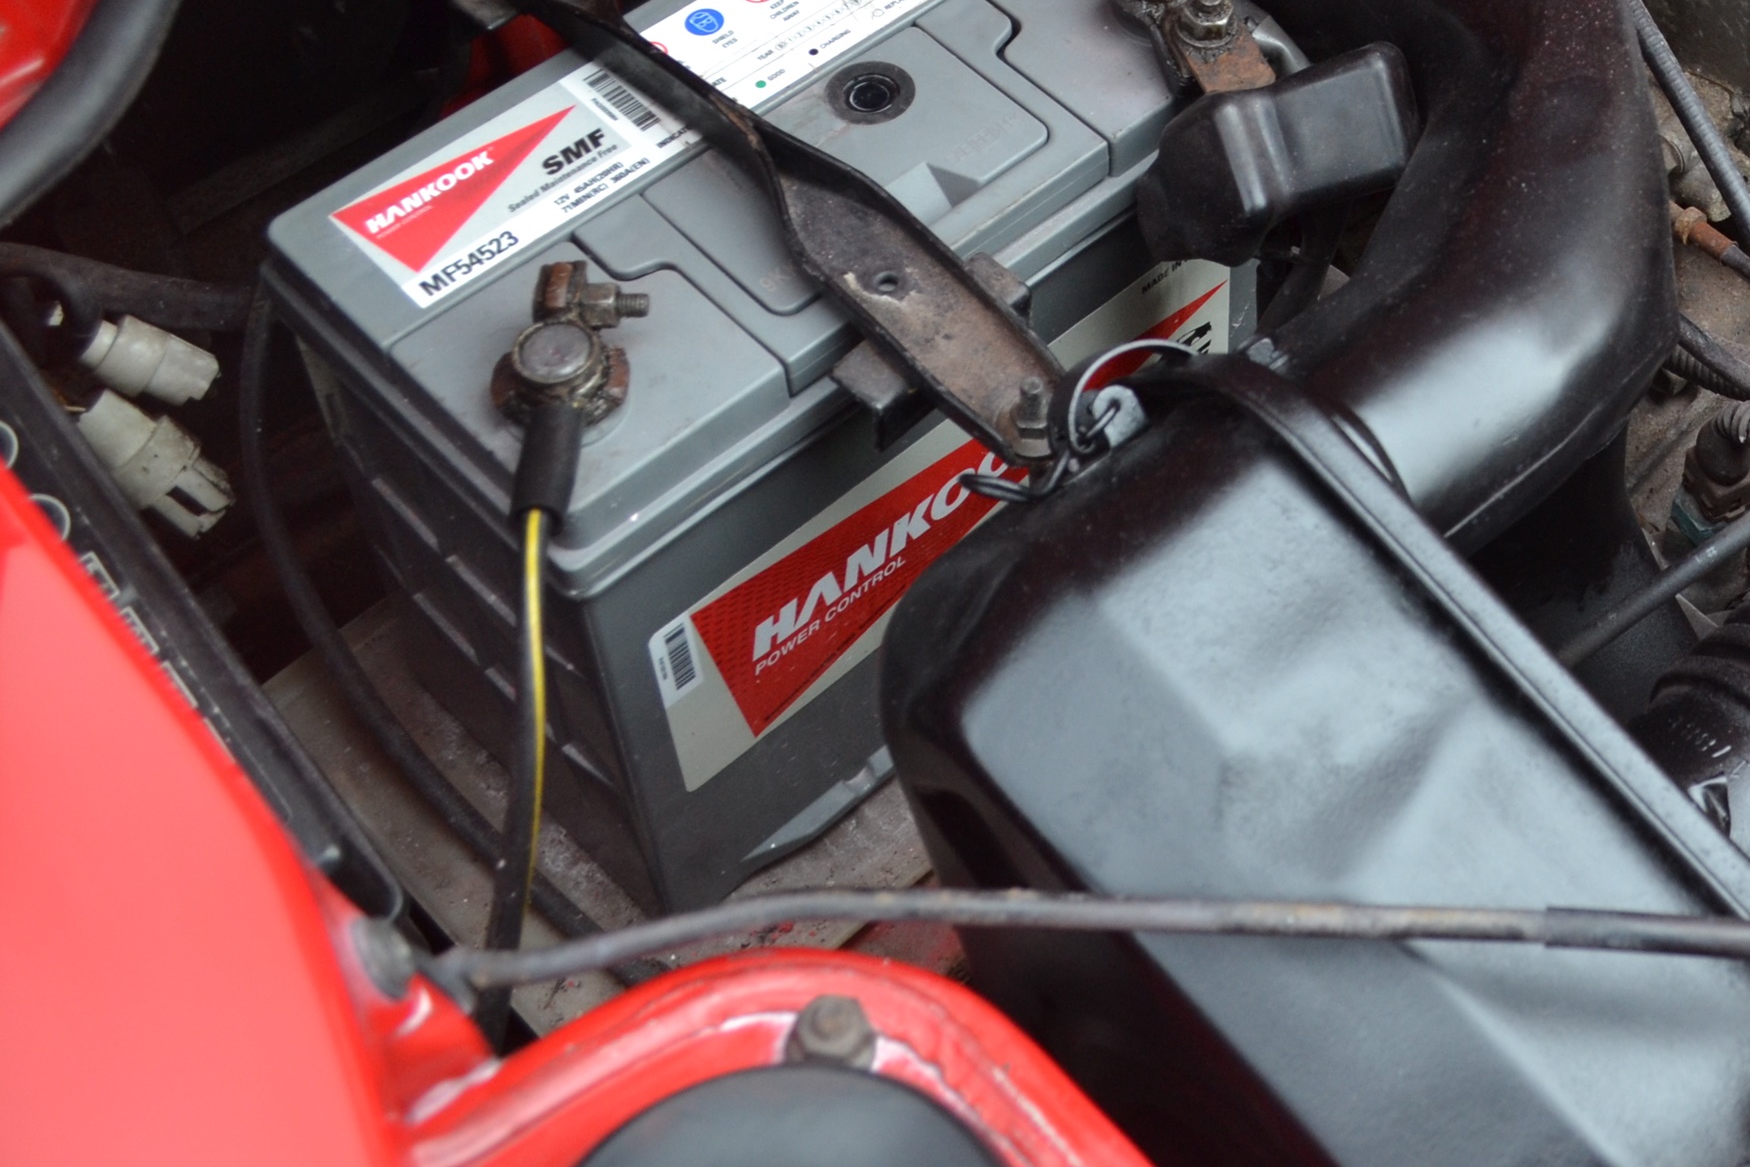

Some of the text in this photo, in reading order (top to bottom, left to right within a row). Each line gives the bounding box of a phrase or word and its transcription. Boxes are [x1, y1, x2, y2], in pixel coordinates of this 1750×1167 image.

[508, 144, 618, 213] Sealed Maintenance Free
[542, 128, 604, 175] SMF
[366, 151, 493, 232] HANKOOK
[554, 194, 570, 205] 12V
[419, 231, 519, 296] MF54523
[754, 621, 820, 675] POWER
[825, 556, 906, 620] CONTROL
